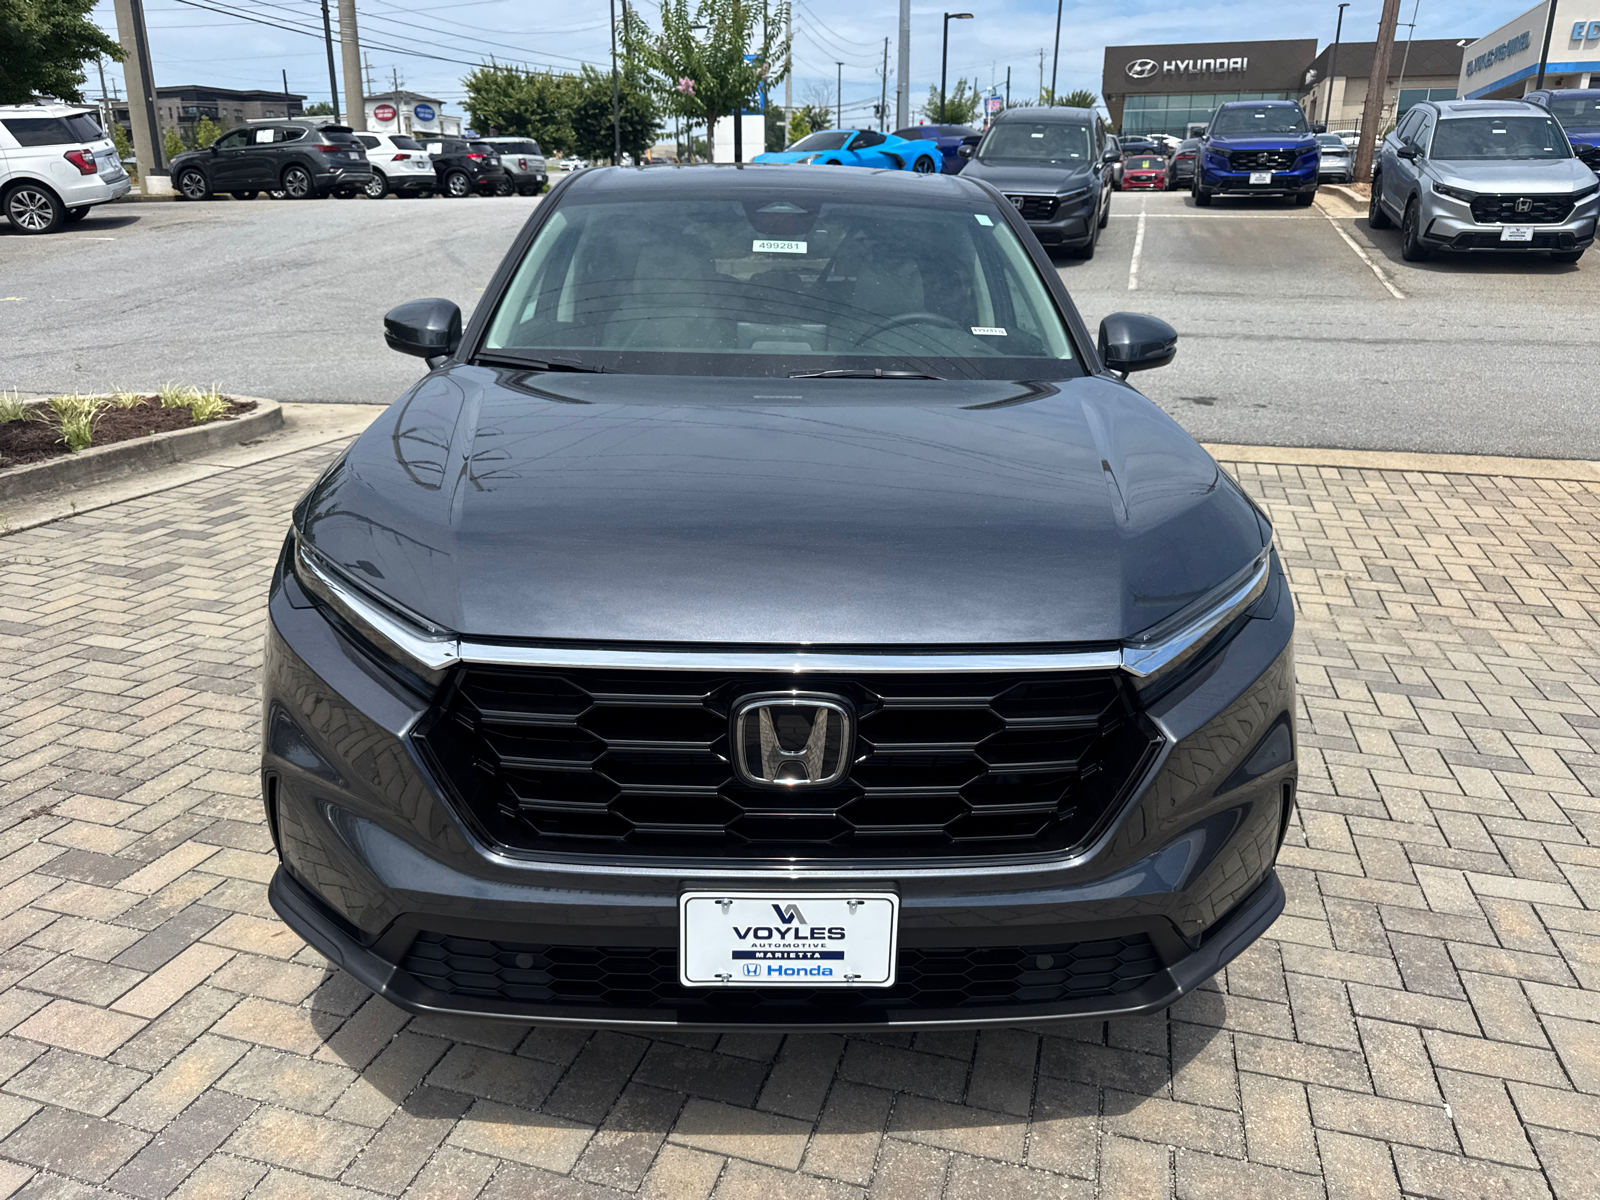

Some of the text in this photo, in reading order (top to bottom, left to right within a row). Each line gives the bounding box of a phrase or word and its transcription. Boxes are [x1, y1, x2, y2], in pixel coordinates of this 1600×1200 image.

[1163, 57, 1248, 74] HYUNDAI
[758, 242, 799, 250] 499281
[732, 926, 846, 940] VOYLES
[767, 965, 833, 977] Honda
